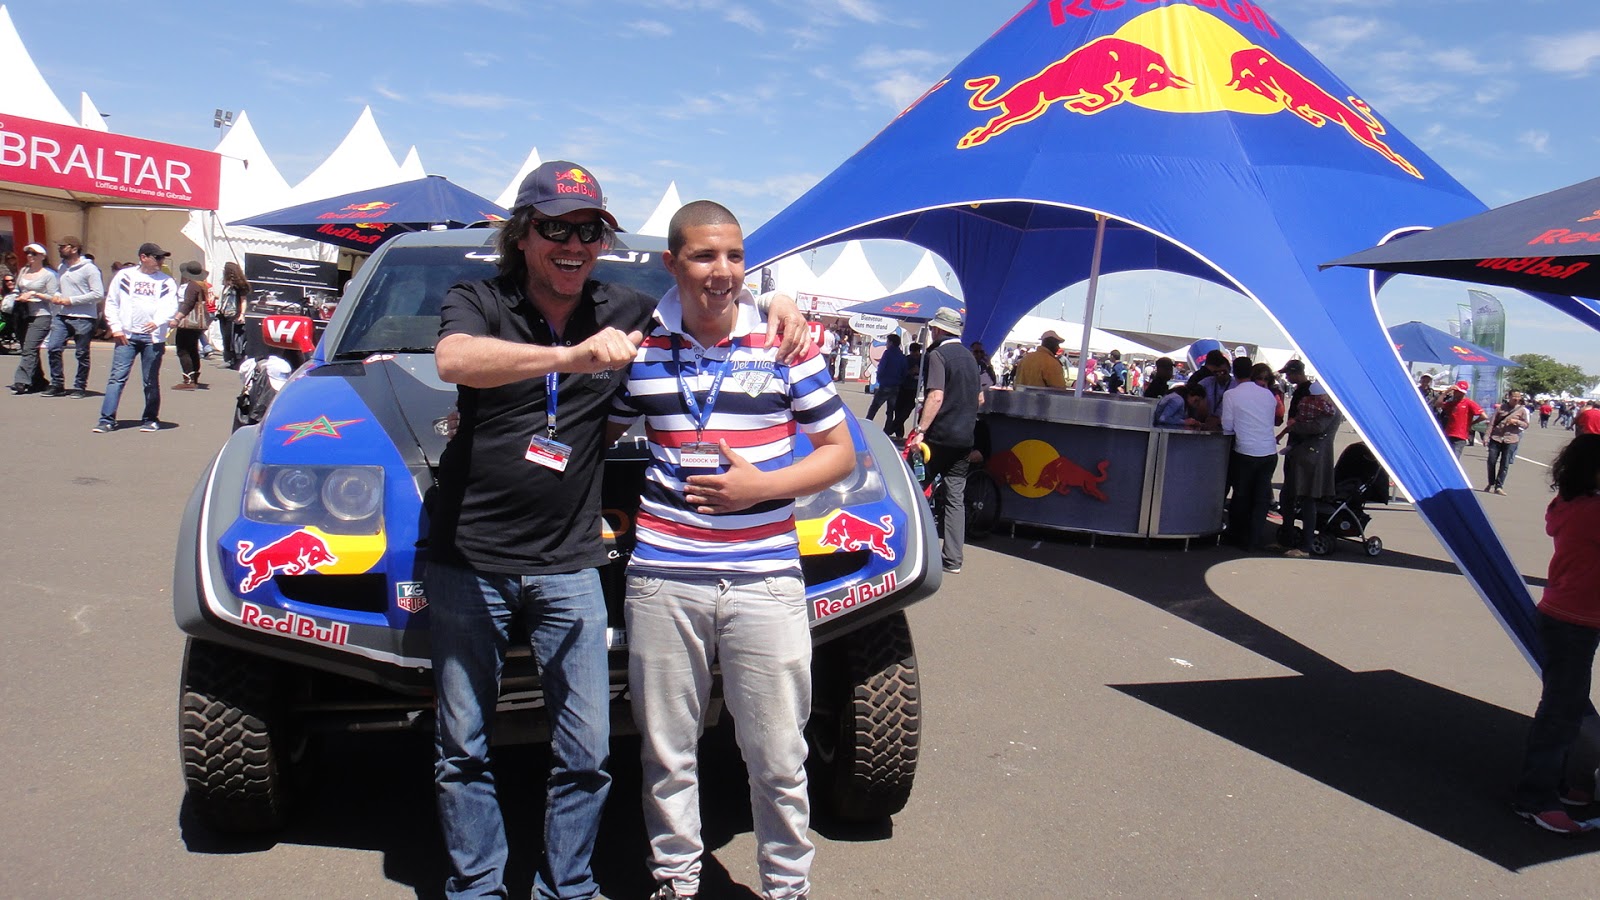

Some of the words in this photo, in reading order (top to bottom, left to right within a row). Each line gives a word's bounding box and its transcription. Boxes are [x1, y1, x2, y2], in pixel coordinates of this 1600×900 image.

[1193, 0, 1280, 39] ull
[95, 181, 118, 190] L'office
[129, 187, 155, 196] tourisme
[166, 191, 192, 201] Gibraltar
[557, 182, 580, 194] Red
[400, 598, 428, 611] HEUER
[814, 586, 858, 619] Red
[859, 572, 897, 603] Bull
[241, 603, 295, 634] Red
[297, 617, 347, 646] Bull
